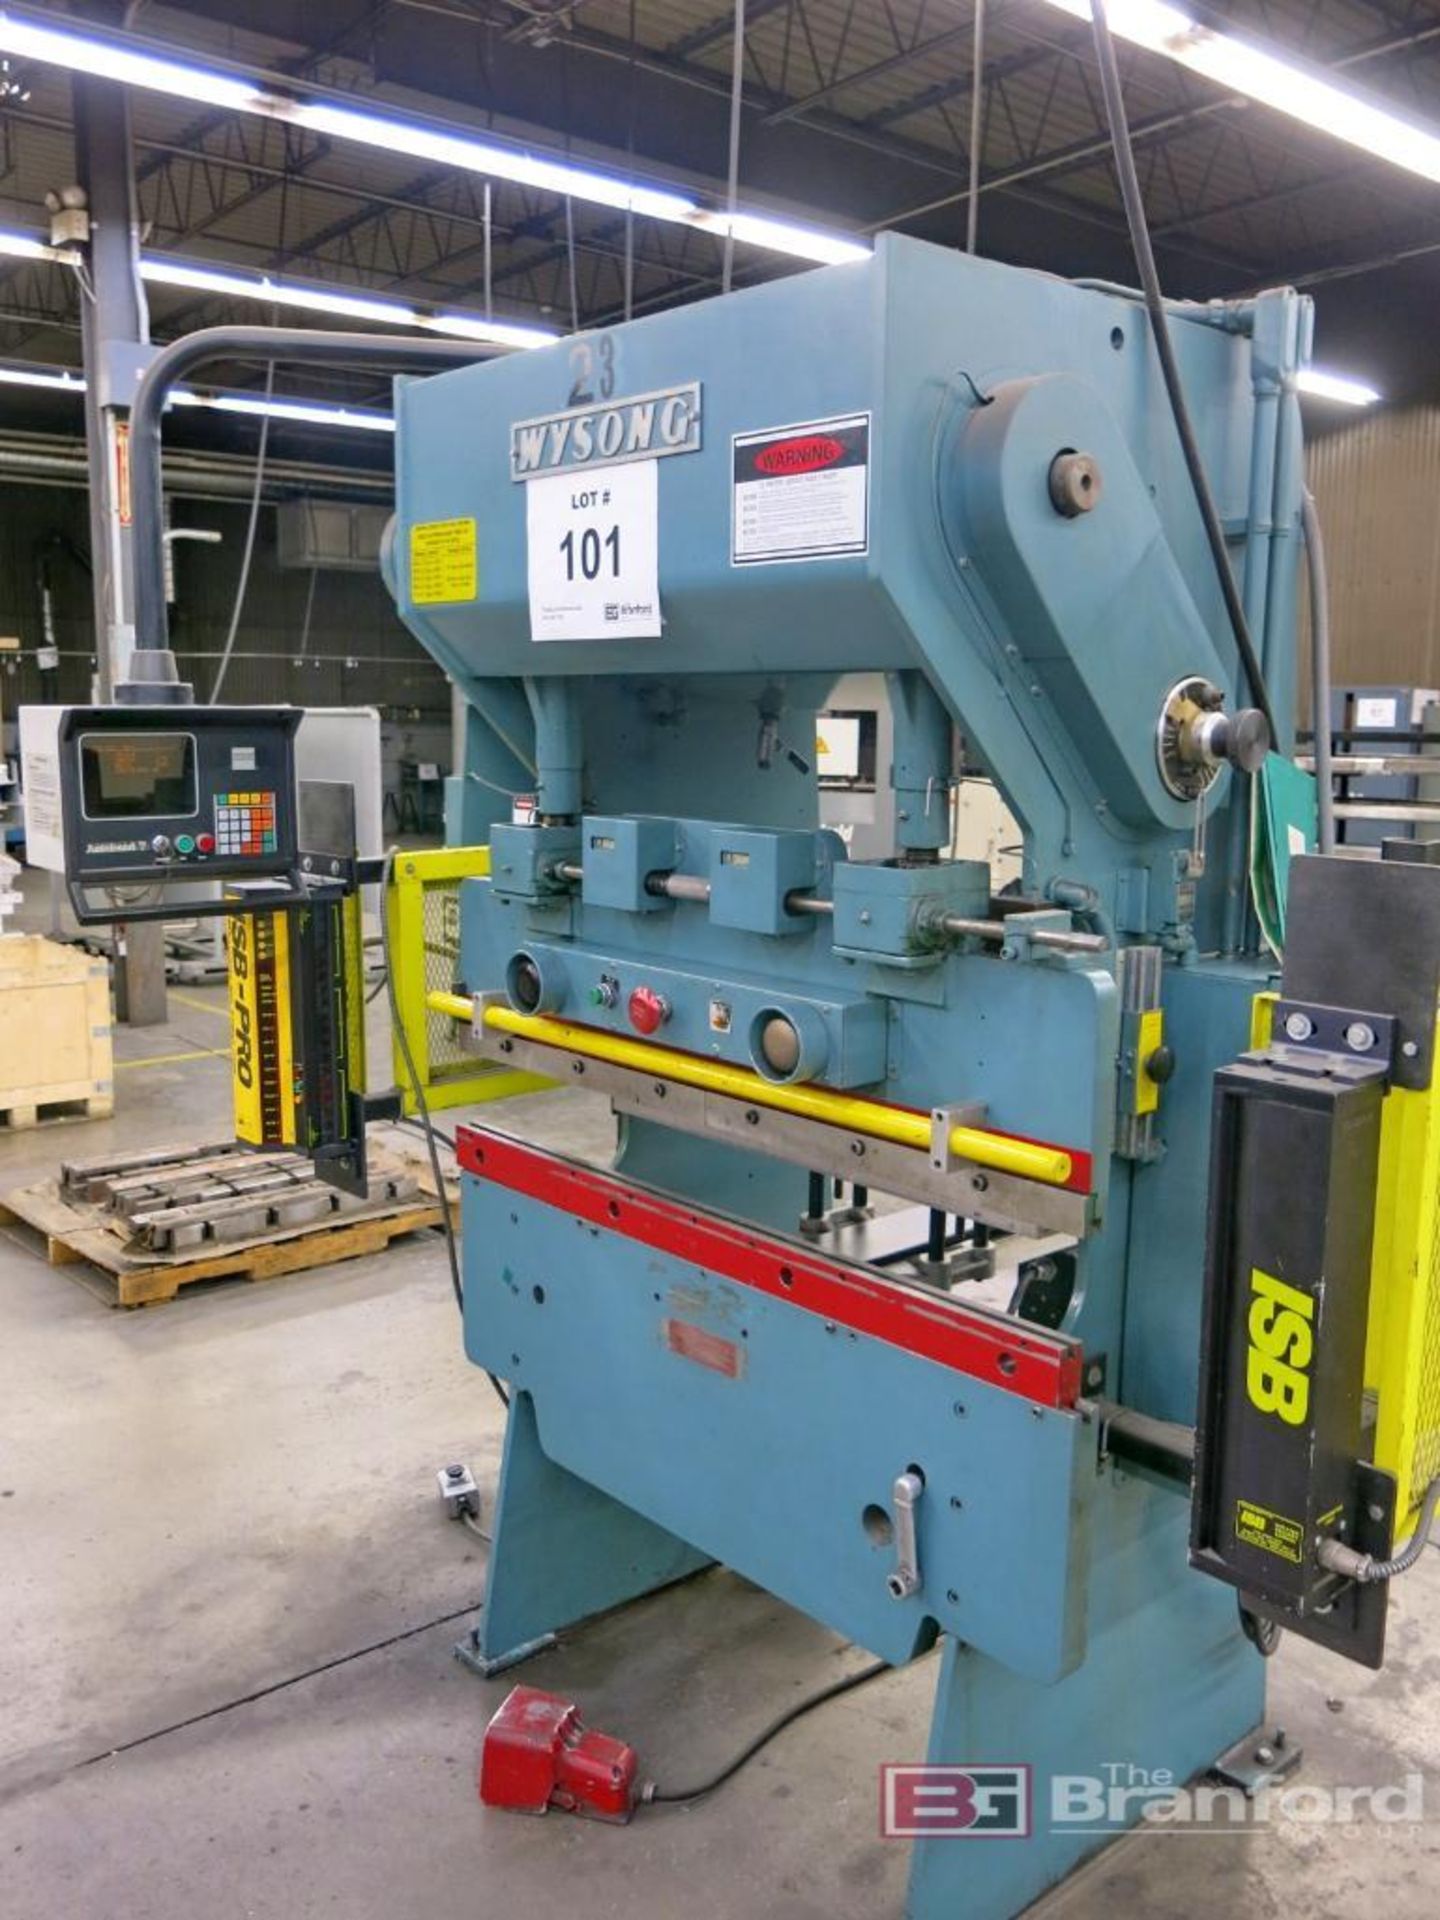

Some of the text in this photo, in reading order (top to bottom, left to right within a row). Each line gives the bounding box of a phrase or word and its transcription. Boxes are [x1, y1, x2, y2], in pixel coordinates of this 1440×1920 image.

[568, 334, 615, 407] 23
[518, 396, 691, 473] WYSONG
[763, 440, 833, 470] WARNING
[571, 487, 612, 510] LOT #
[560, 524, 620, 581] 101
[1247, 1267, 1314, 1425] ISB
